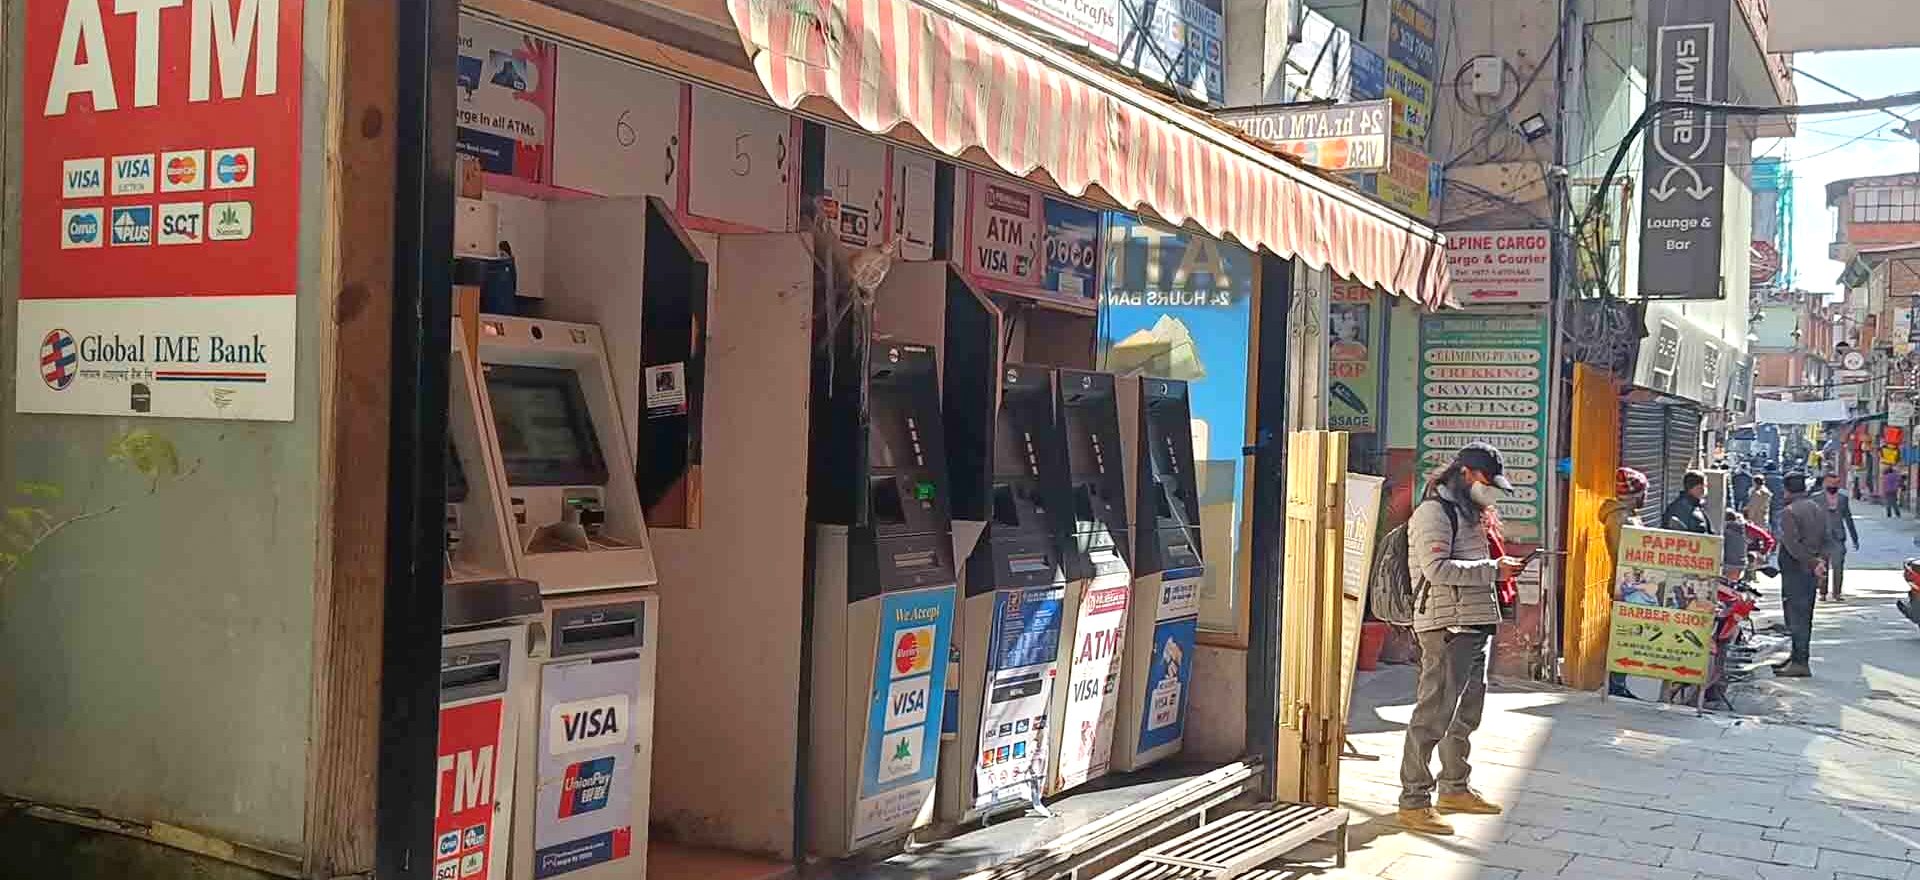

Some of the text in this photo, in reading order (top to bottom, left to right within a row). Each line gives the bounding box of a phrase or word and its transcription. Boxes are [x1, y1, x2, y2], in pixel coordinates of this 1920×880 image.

[44, 0, 280, 117] ATM
[492, 116, 505, 129] all
[507, 119, 536, 136] ATMs
[617, 109, 636, 147] 6
[731, 131, 752, 176] 5
[68, 170, 100, 188] VISA
[118, 159, 150, 179] VISA
[125, 226, 151, 242] PLUS
[162, 213, 199, 236] SCT
[986, 216, 1022, 246] ATM
[1647, 217, 1712, 231] Lounge &
[1496, 236, 1547, 250] CARGO
[1666, 240, 1691, 250] Bar
[978, 246, 1009, 274] VISA
[1448, 256, 1479, 267] argo
[1498, 253, 1547, 264] Courier
[80, 334, 267, 363] Global IME Bank
[1438, 367, 1527, 378] TREKKING
[1438, 384, 1527, 395] KAYAKING
[1438, 401, 1525, 412] RAFTING
[1642, 535, 1701, 553] PAPPU
[1626, 547, 1713, 569] HAIR DRESSER
[1618, 606, 1670, 624] BARBER
[1080, 628, 1119, 664] ATM
[1074, 678, 1099, 704] VISA
[892, 688, 925, 716] VISA
[561, 706, 619, 742] VISA
[436, 744, 494, 818] TM
[565, 771, 612, 792] UnionPay
